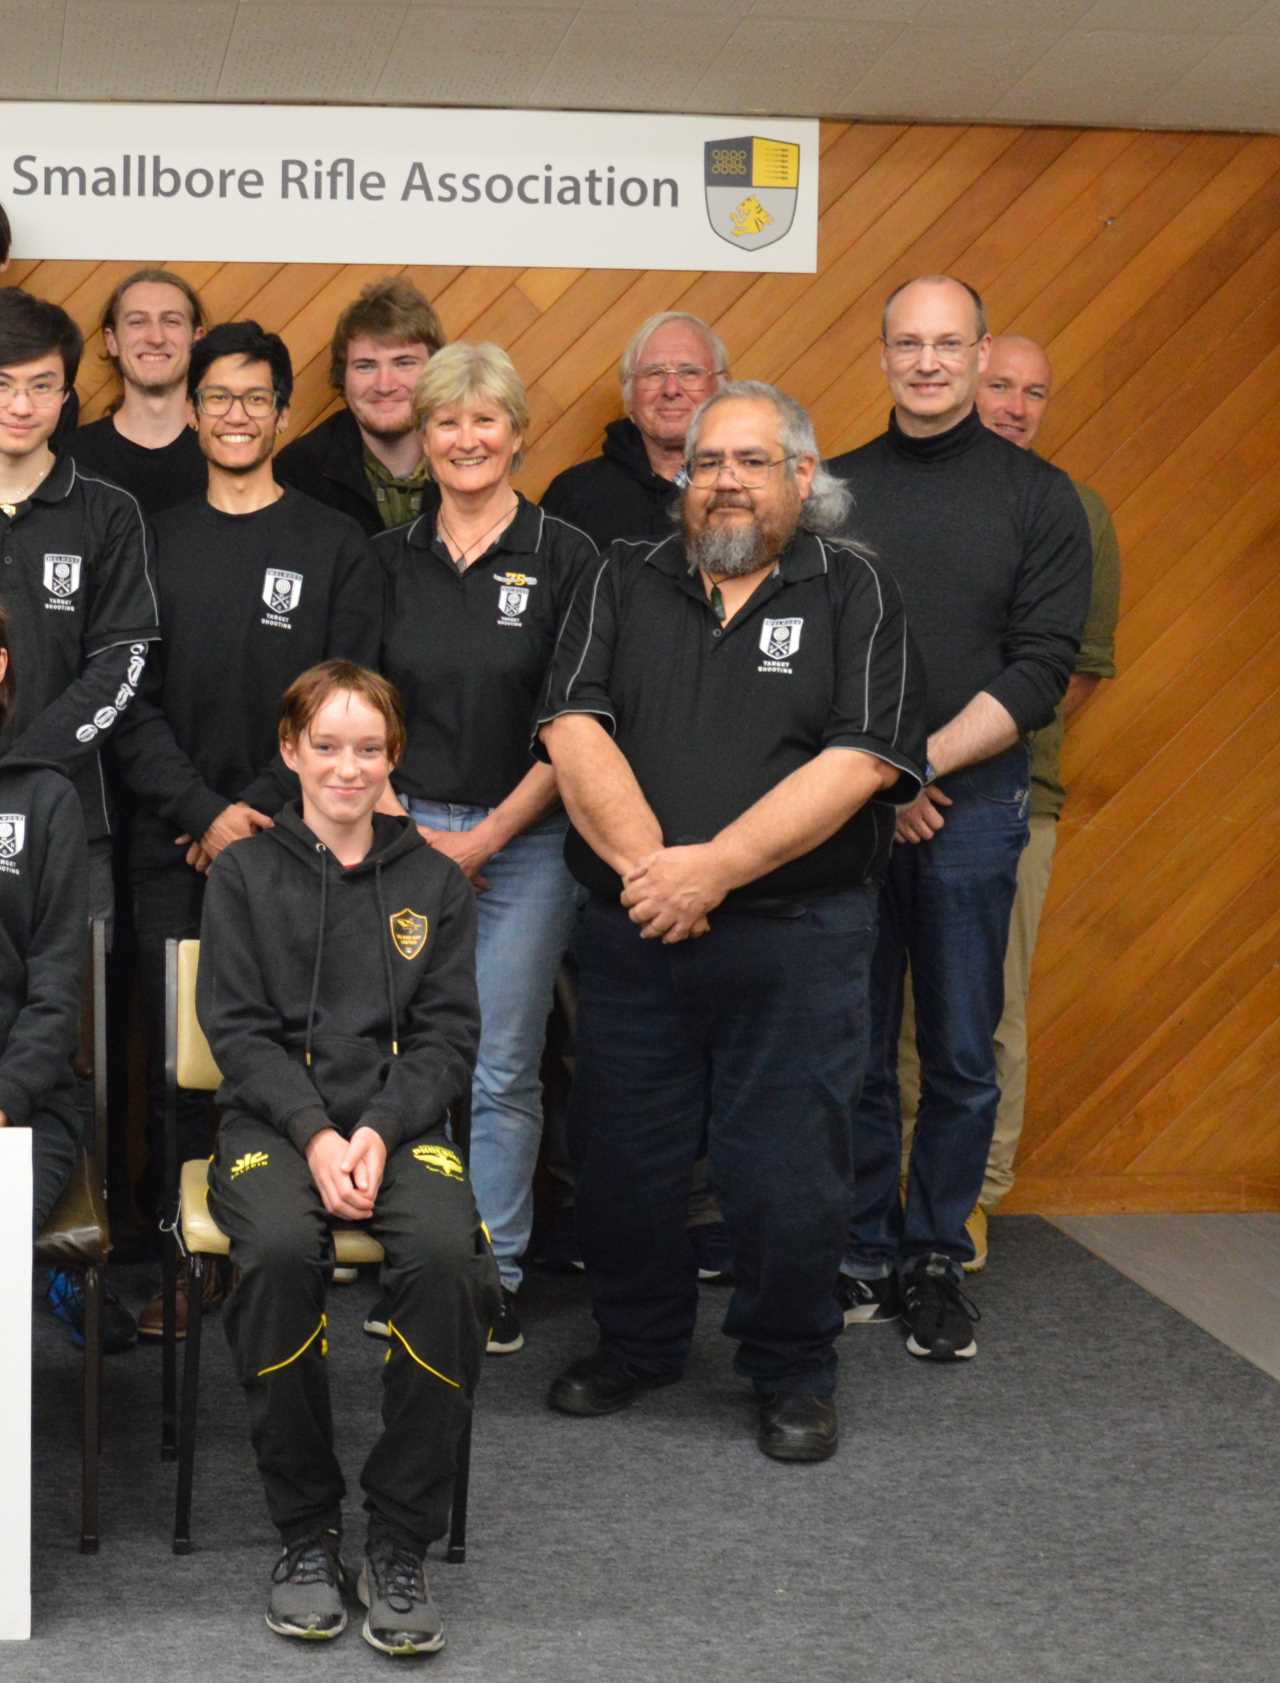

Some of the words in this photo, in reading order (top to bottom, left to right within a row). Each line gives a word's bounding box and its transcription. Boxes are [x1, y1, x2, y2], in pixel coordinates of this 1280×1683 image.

[12, 154, 264, 198] Smallbore
[280, 158, 386, 202] Rifle
[401, 162, 680, 208] Association
